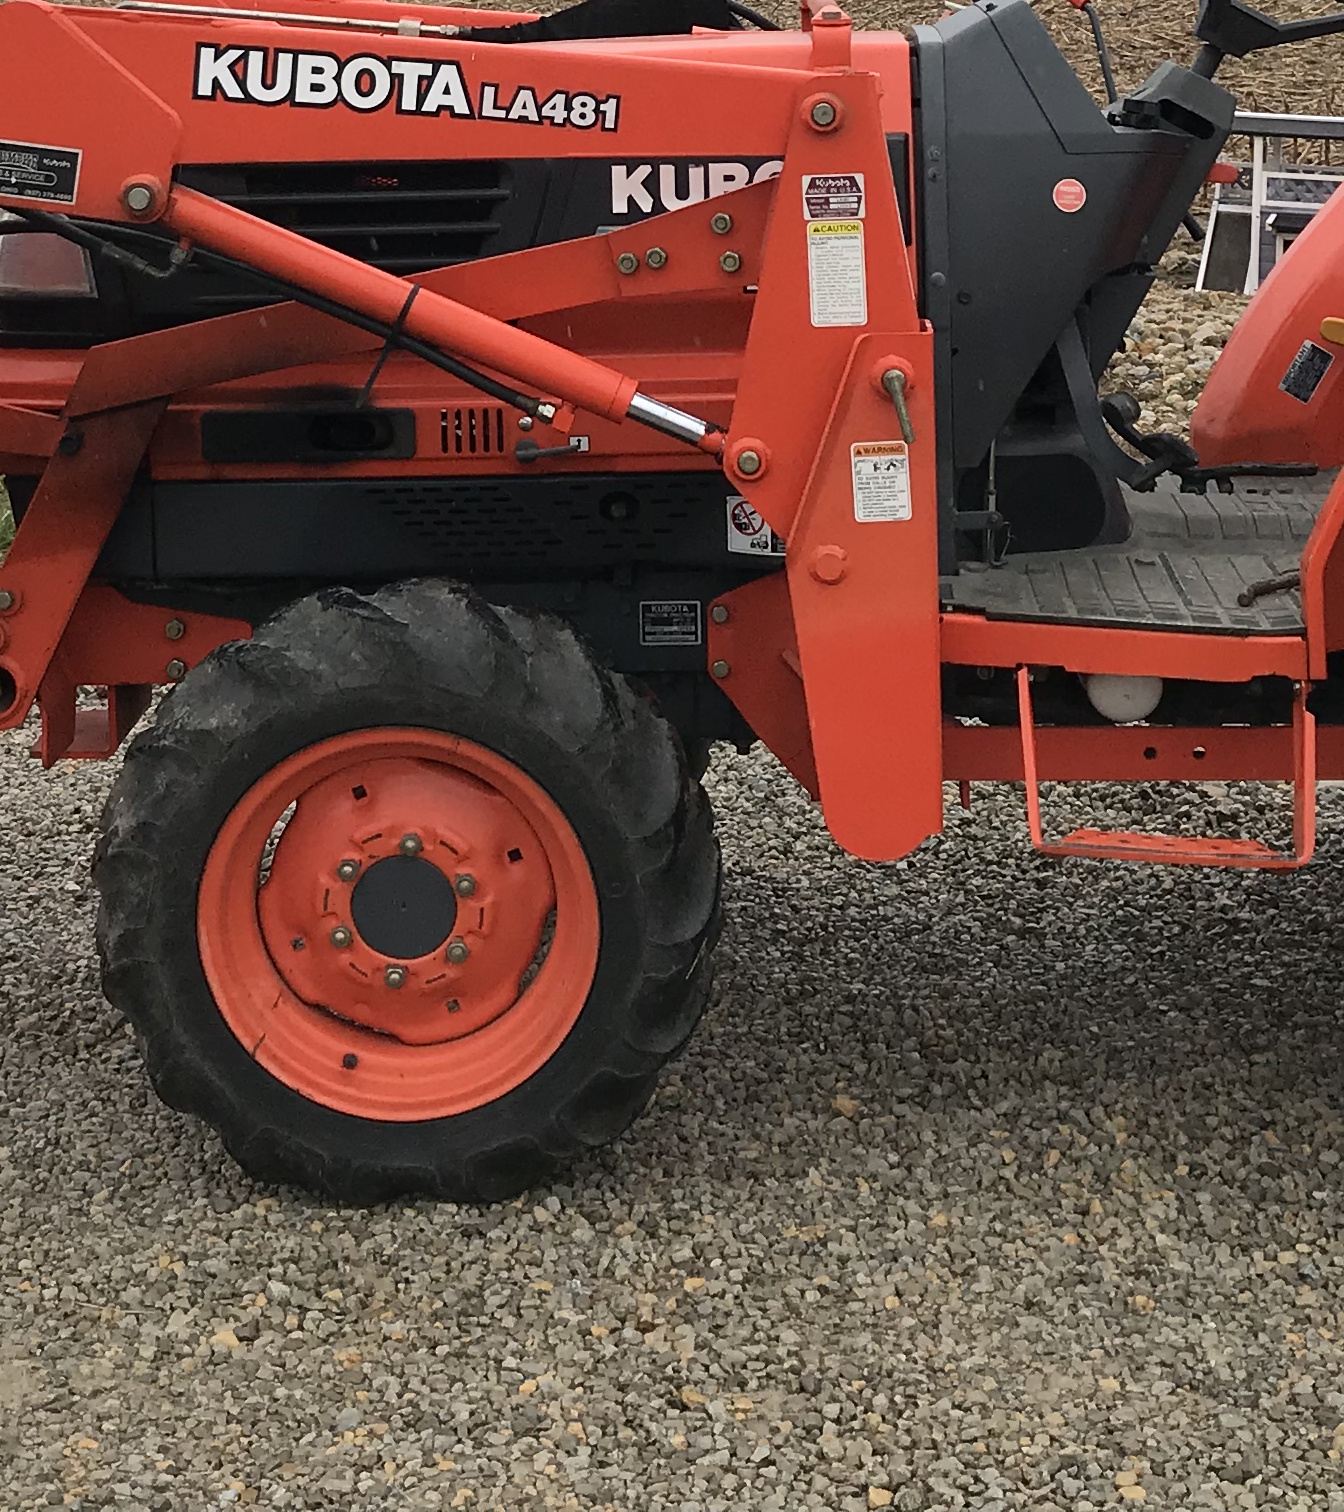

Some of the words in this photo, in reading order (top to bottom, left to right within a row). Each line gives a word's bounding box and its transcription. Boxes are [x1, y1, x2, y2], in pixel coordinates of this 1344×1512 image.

[195, 44, 474, 117] KUBOTA
[479, 84, 619, 131] LA481
[11, 171, 46, 182] SERVICE
[820, 224, 860, 233] CAUTION
[862, 445, 904, 454] WARNING
[651, 604, 690, 613] KUBOTA
